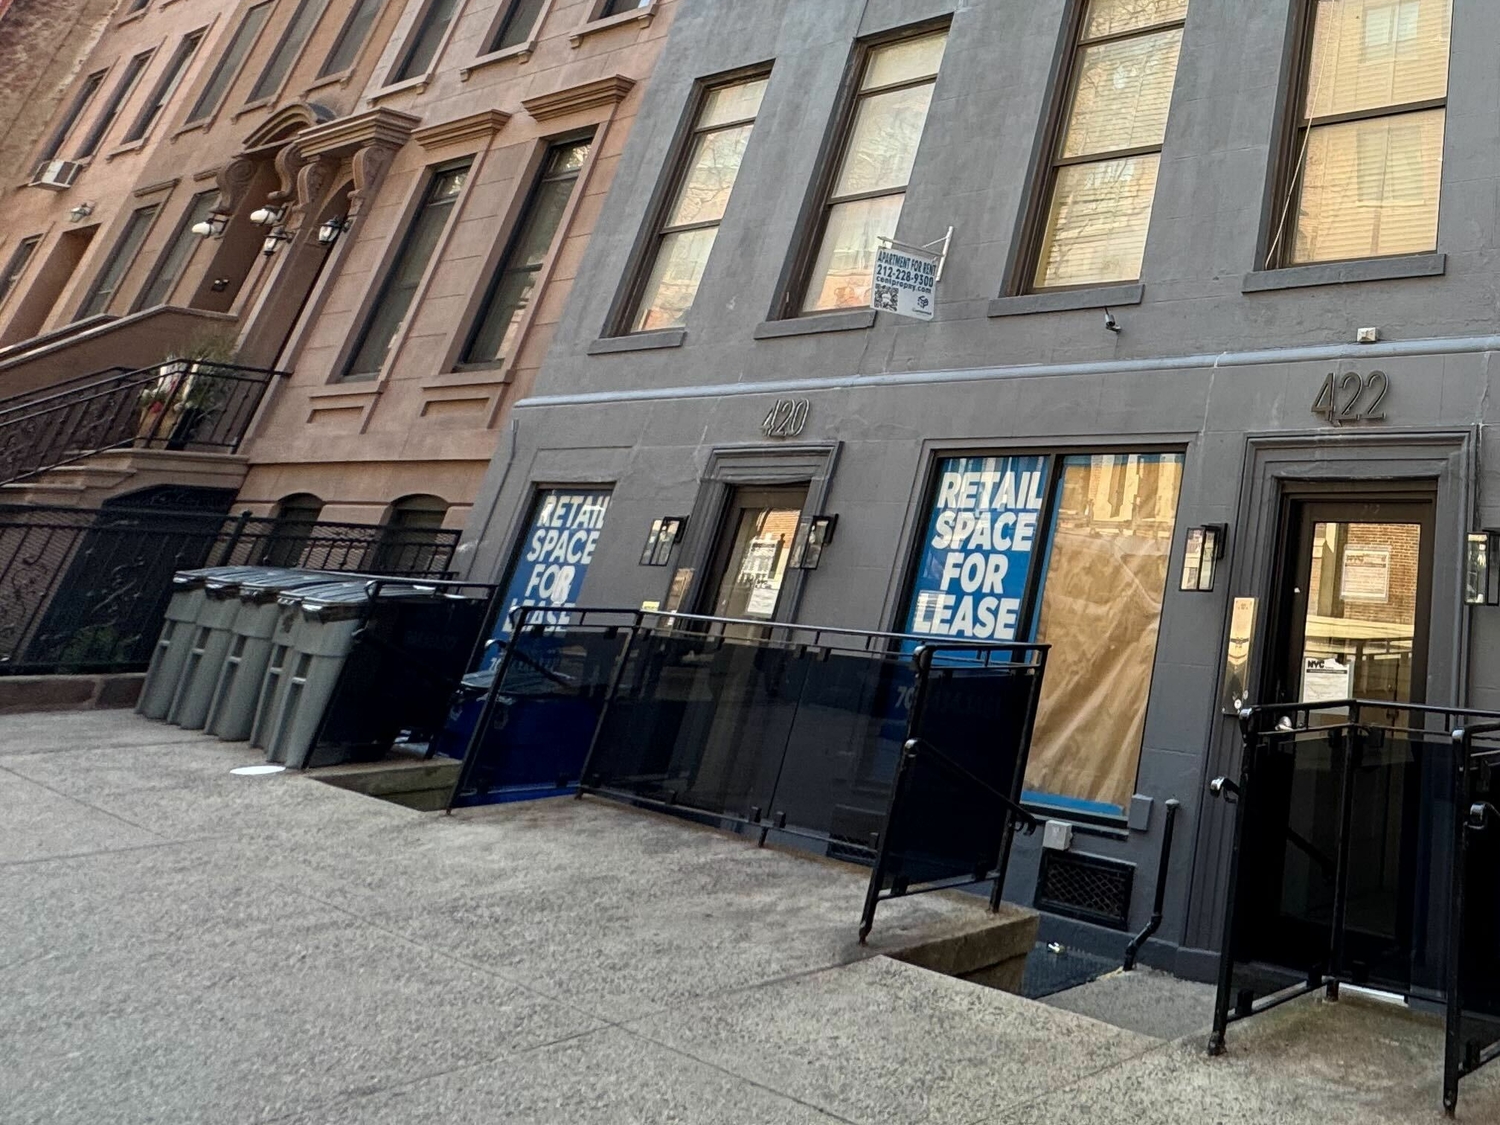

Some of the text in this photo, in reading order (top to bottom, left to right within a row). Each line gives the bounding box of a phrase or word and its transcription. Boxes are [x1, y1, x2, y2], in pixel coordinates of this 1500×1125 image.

[878, 250, 936, 276] APARTMENT FOR RENT
[1311, 370, 1389, 422] 422
[762, 399, 810, 437] 420
[936, 471, 1043, 510] RETAIL
[536, 495, 611, 529] RETAIL
[931, 511, 1037, 552] SPACE
[526, 528, 600, 565] SPACE
[525, 563, 576, 604] FOR
[940, 552, 1009, 595] FOR
[912, 592, 1021, 640] LEASE
[1307, 660, 1325, 669] NYC
